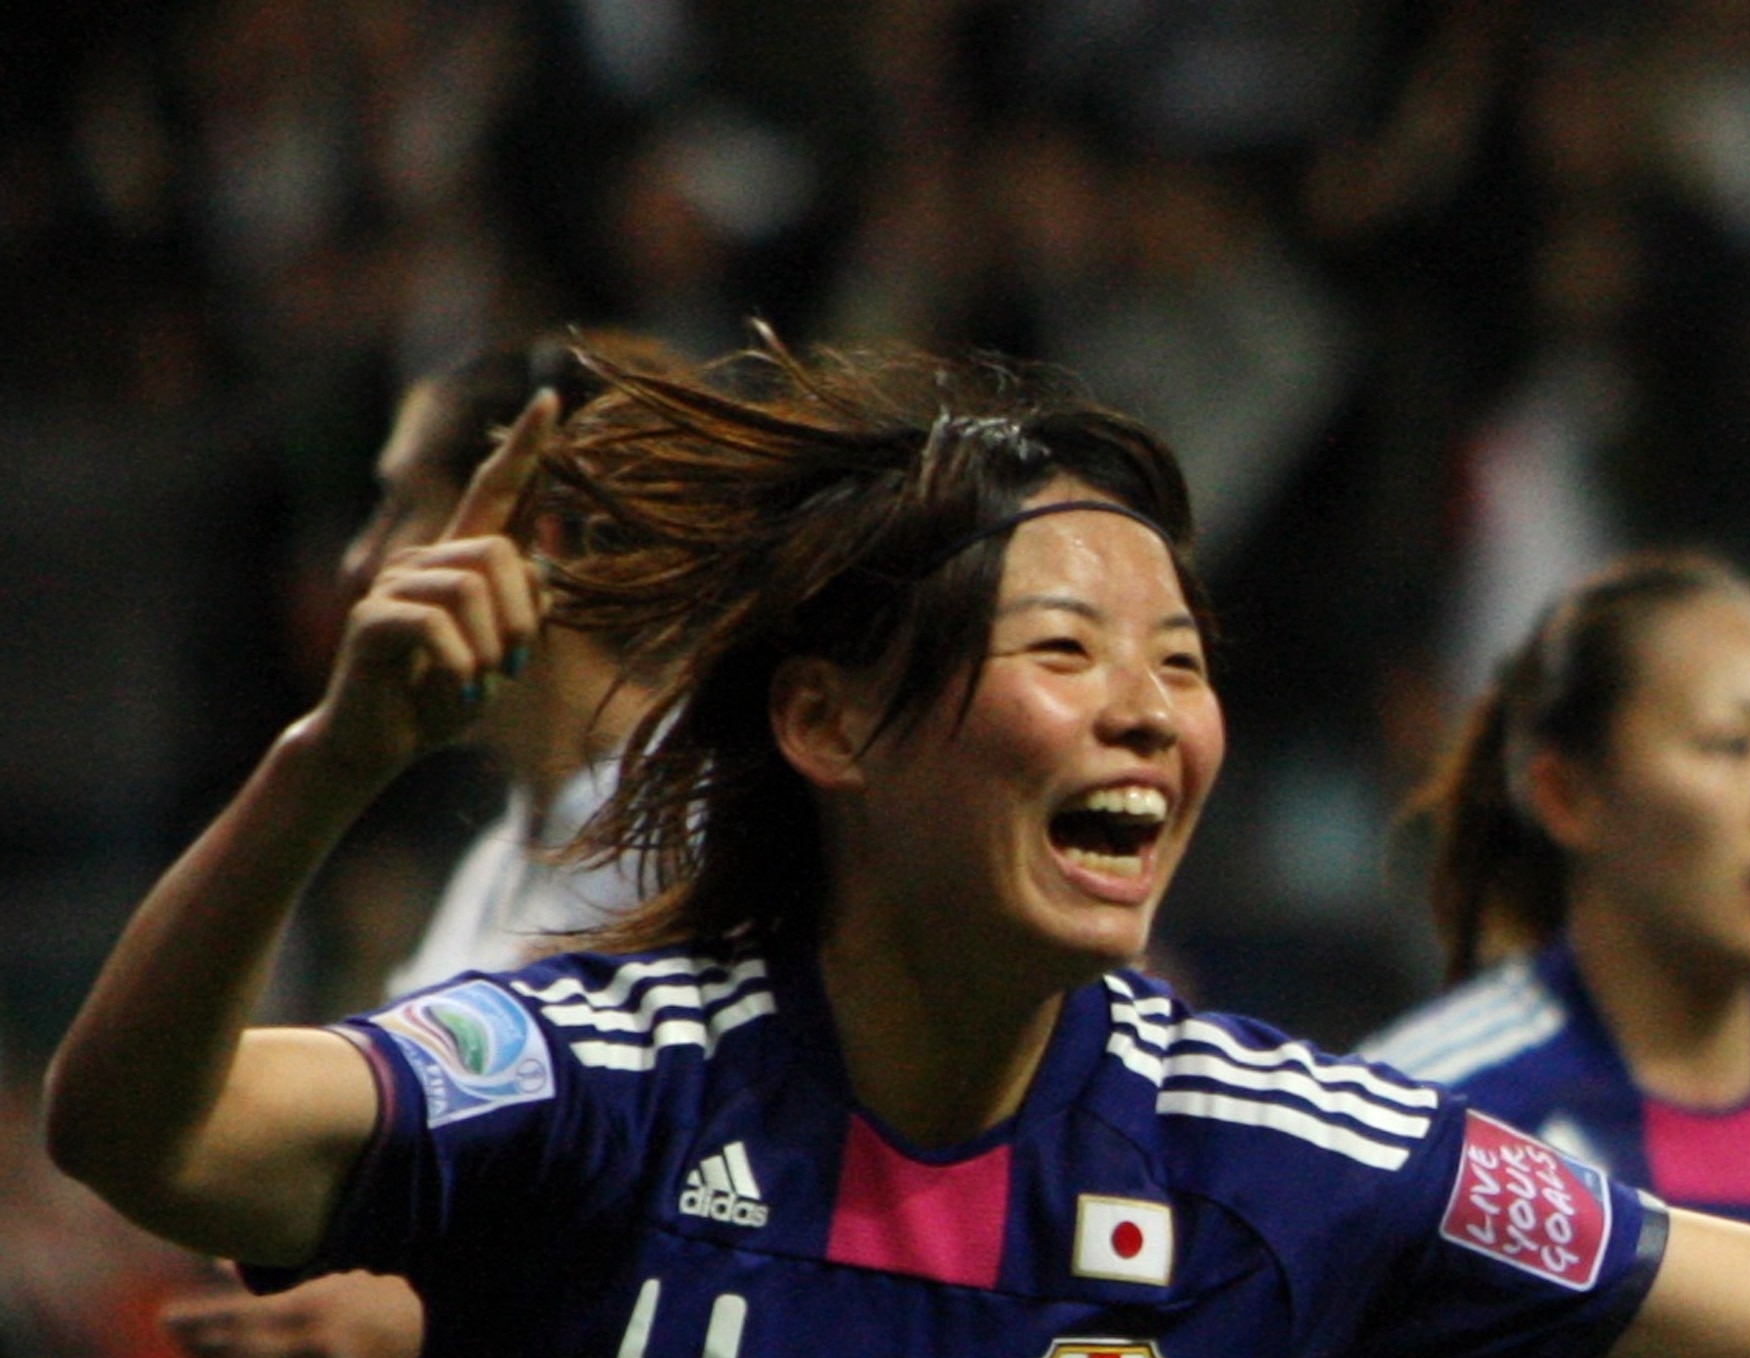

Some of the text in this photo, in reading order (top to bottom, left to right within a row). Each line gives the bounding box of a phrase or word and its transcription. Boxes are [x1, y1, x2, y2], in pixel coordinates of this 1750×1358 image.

[679, 1185, 769, 1228] adidas
[1466, 1145, 1501, 1243] LIVE
[1500, 1146, 1539, 1255] YOUR
[1525, 1145, 1580, 1273] GOALS
